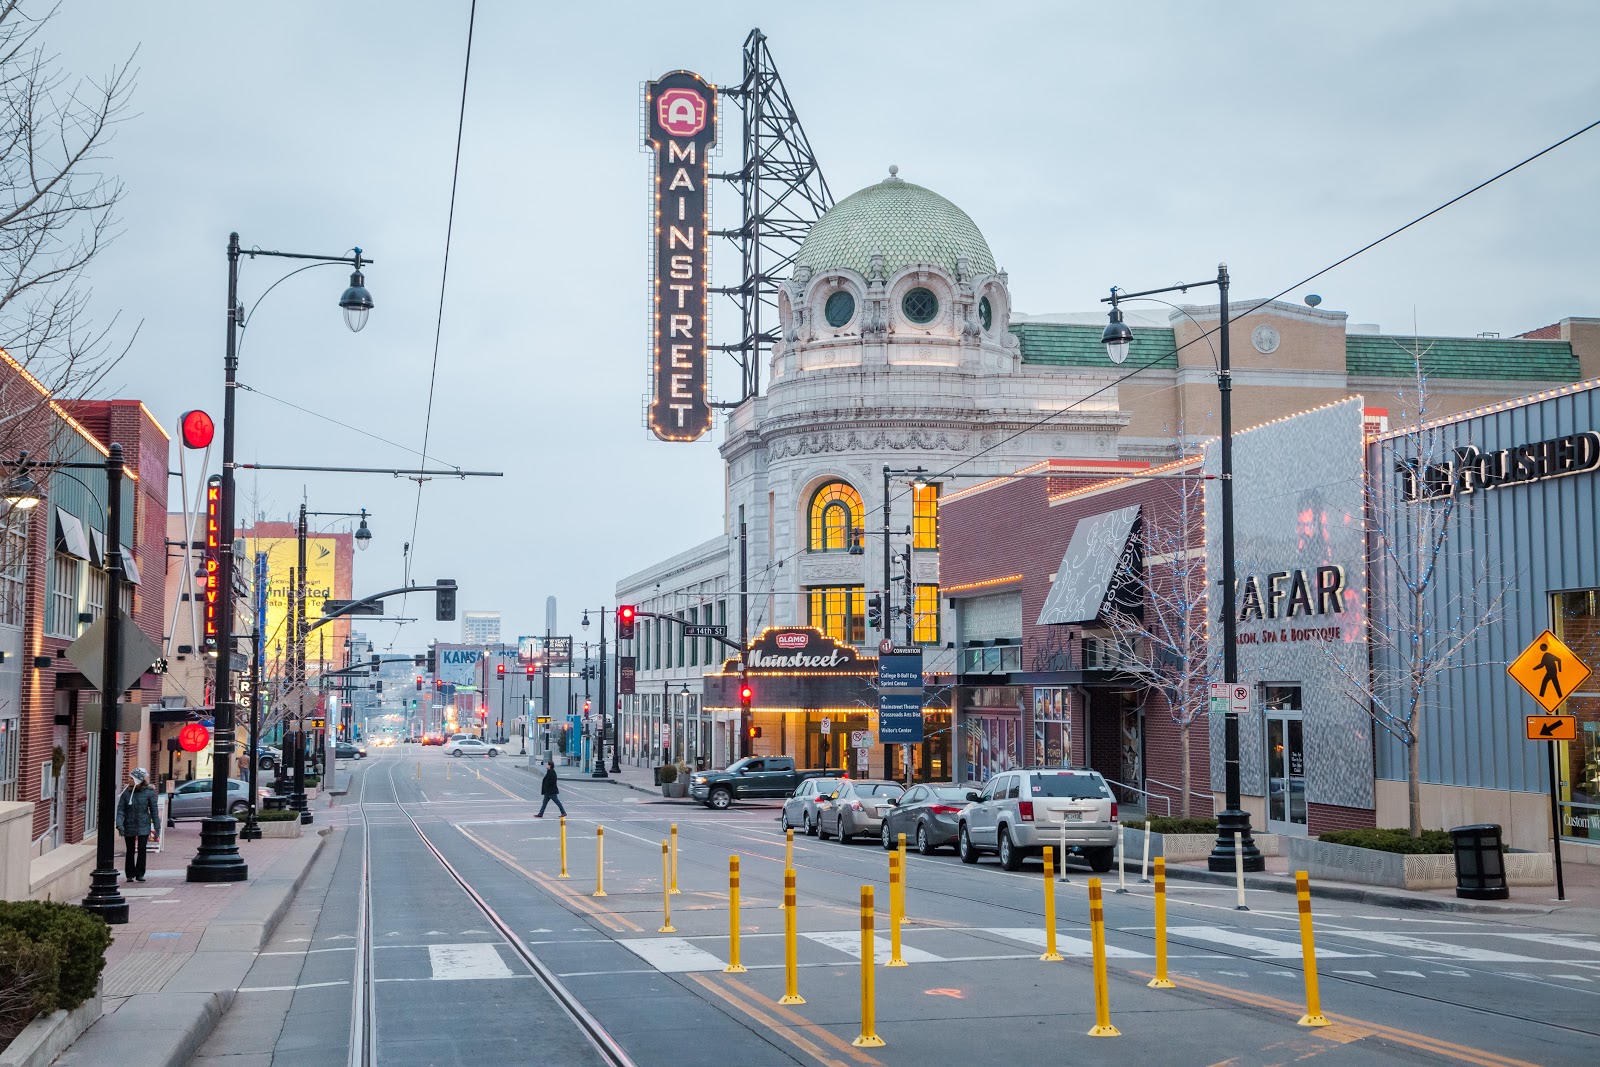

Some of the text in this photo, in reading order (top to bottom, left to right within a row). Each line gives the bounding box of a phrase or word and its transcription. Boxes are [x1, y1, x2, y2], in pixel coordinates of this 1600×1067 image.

[668, 139, 696, 427] MAINSTREET
[1453, 430, 1600, 493] POLISHED
[208, 488, 218, 547] KILL
[206, 560, 217, 634] DEVIL
[1217, 564, 1346, 623] AFAR
[696, 627, 723, 635] 14th St
[1235, 632, 1259, 645] ALON,
[1280, 628, 1288, 642] &
[443, 650, 487, 664] KANSA
[747, 648, 850, 668] Mainstreet
[1563, 813, 1590, 829] Custom
